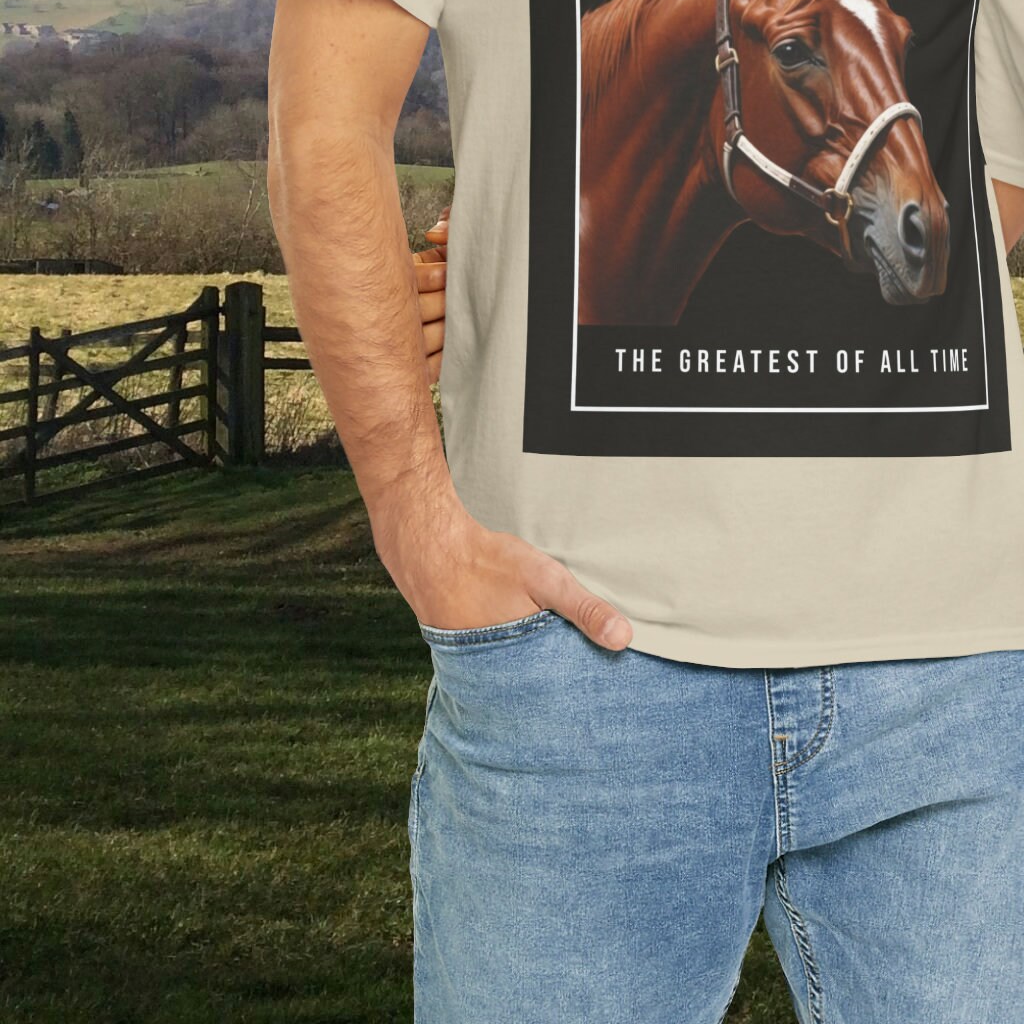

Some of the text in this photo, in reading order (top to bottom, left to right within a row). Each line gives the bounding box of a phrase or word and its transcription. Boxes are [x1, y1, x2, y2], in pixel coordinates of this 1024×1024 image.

[615, 349, 968, 373] THE GREATEST OF ALL TIME
